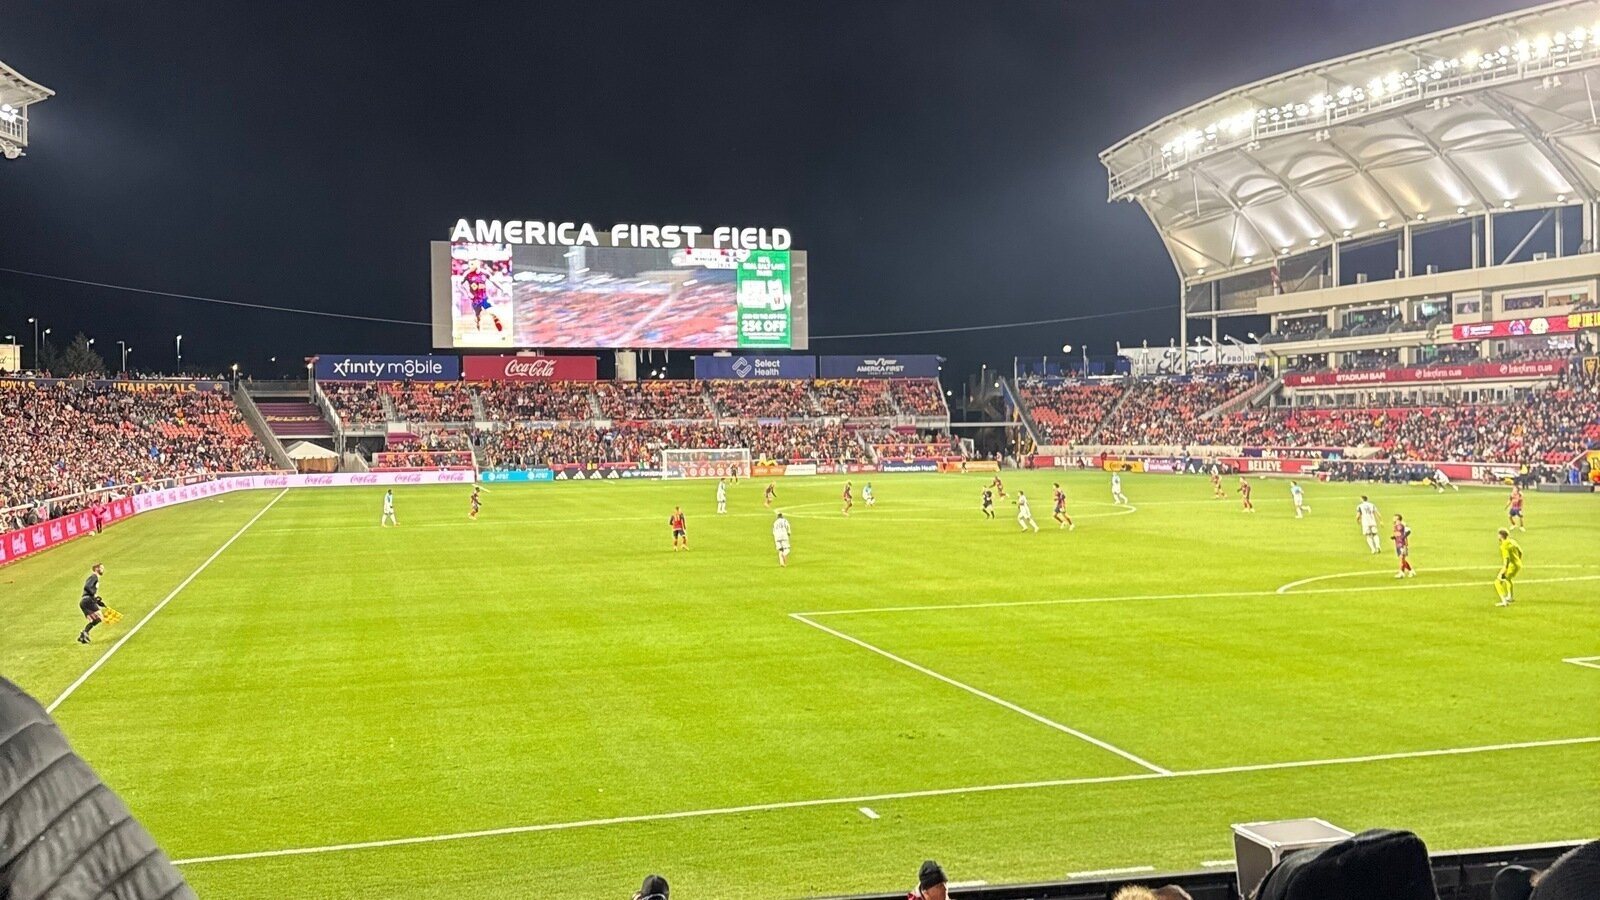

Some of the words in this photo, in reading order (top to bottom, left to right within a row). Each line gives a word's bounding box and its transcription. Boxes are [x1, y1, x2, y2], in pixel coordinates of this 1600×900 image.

[451, 218, 599, 247] AMERICA
[611, 223, 702, 248] FIRST
[713, 226, 791, 250] FIELD
[763, 320, 787, 332] OFF
[333, 359, 385, 376] xfinity
[388, 360, 443, 376] mobile
[754, 359, 780, 368] Select
[754, 368, 780, 376] Health
[1336, 372, 1368, 382] STADIUM
[1369, 371, 1386, 380] BAR
[113, 382, 145, 392] UTAH
[1054, 456, 1094, 466] BELIVE
[1247, 460, 1282, 471] BELIEVE
